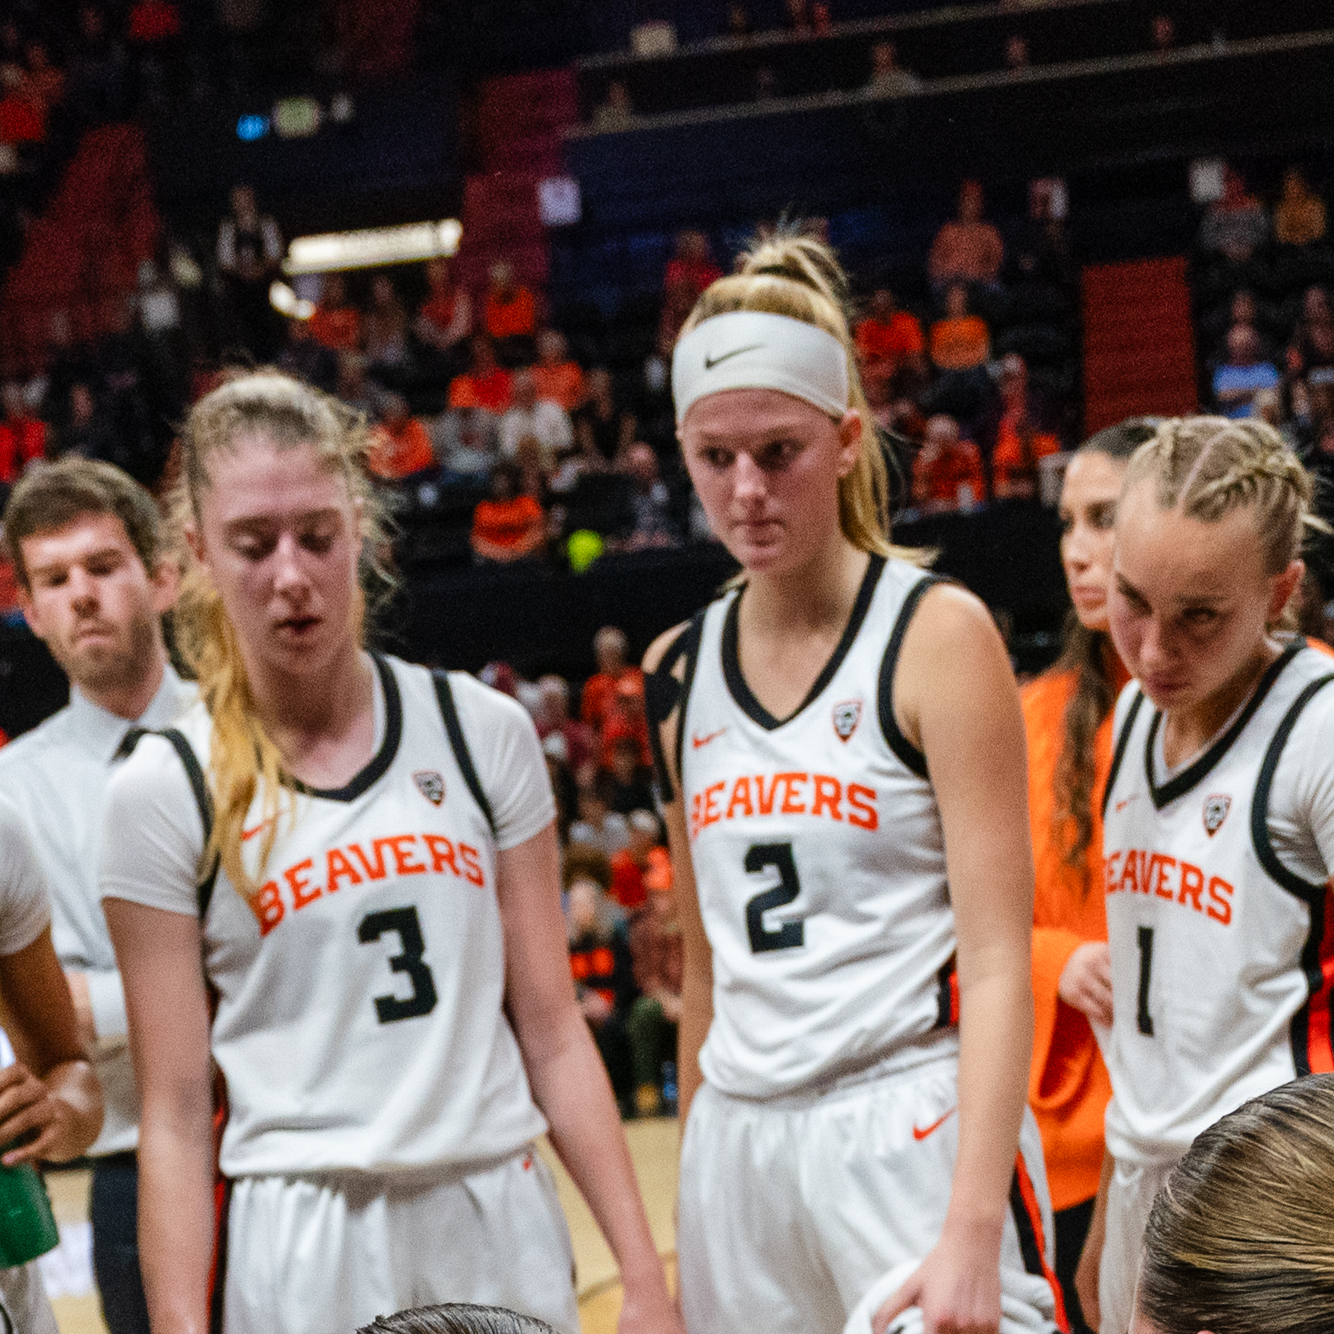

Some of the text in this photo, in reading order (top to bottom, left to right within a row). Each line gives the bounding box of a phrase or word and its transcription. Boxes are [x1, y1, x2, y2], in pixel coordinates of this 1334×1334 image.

[255, 834, 485, 938] BEAVERS
[744, 843, 805, 954] 2
[358, 905, 439, 1024] 3
[1135, 925, 1156, 1037] 1
